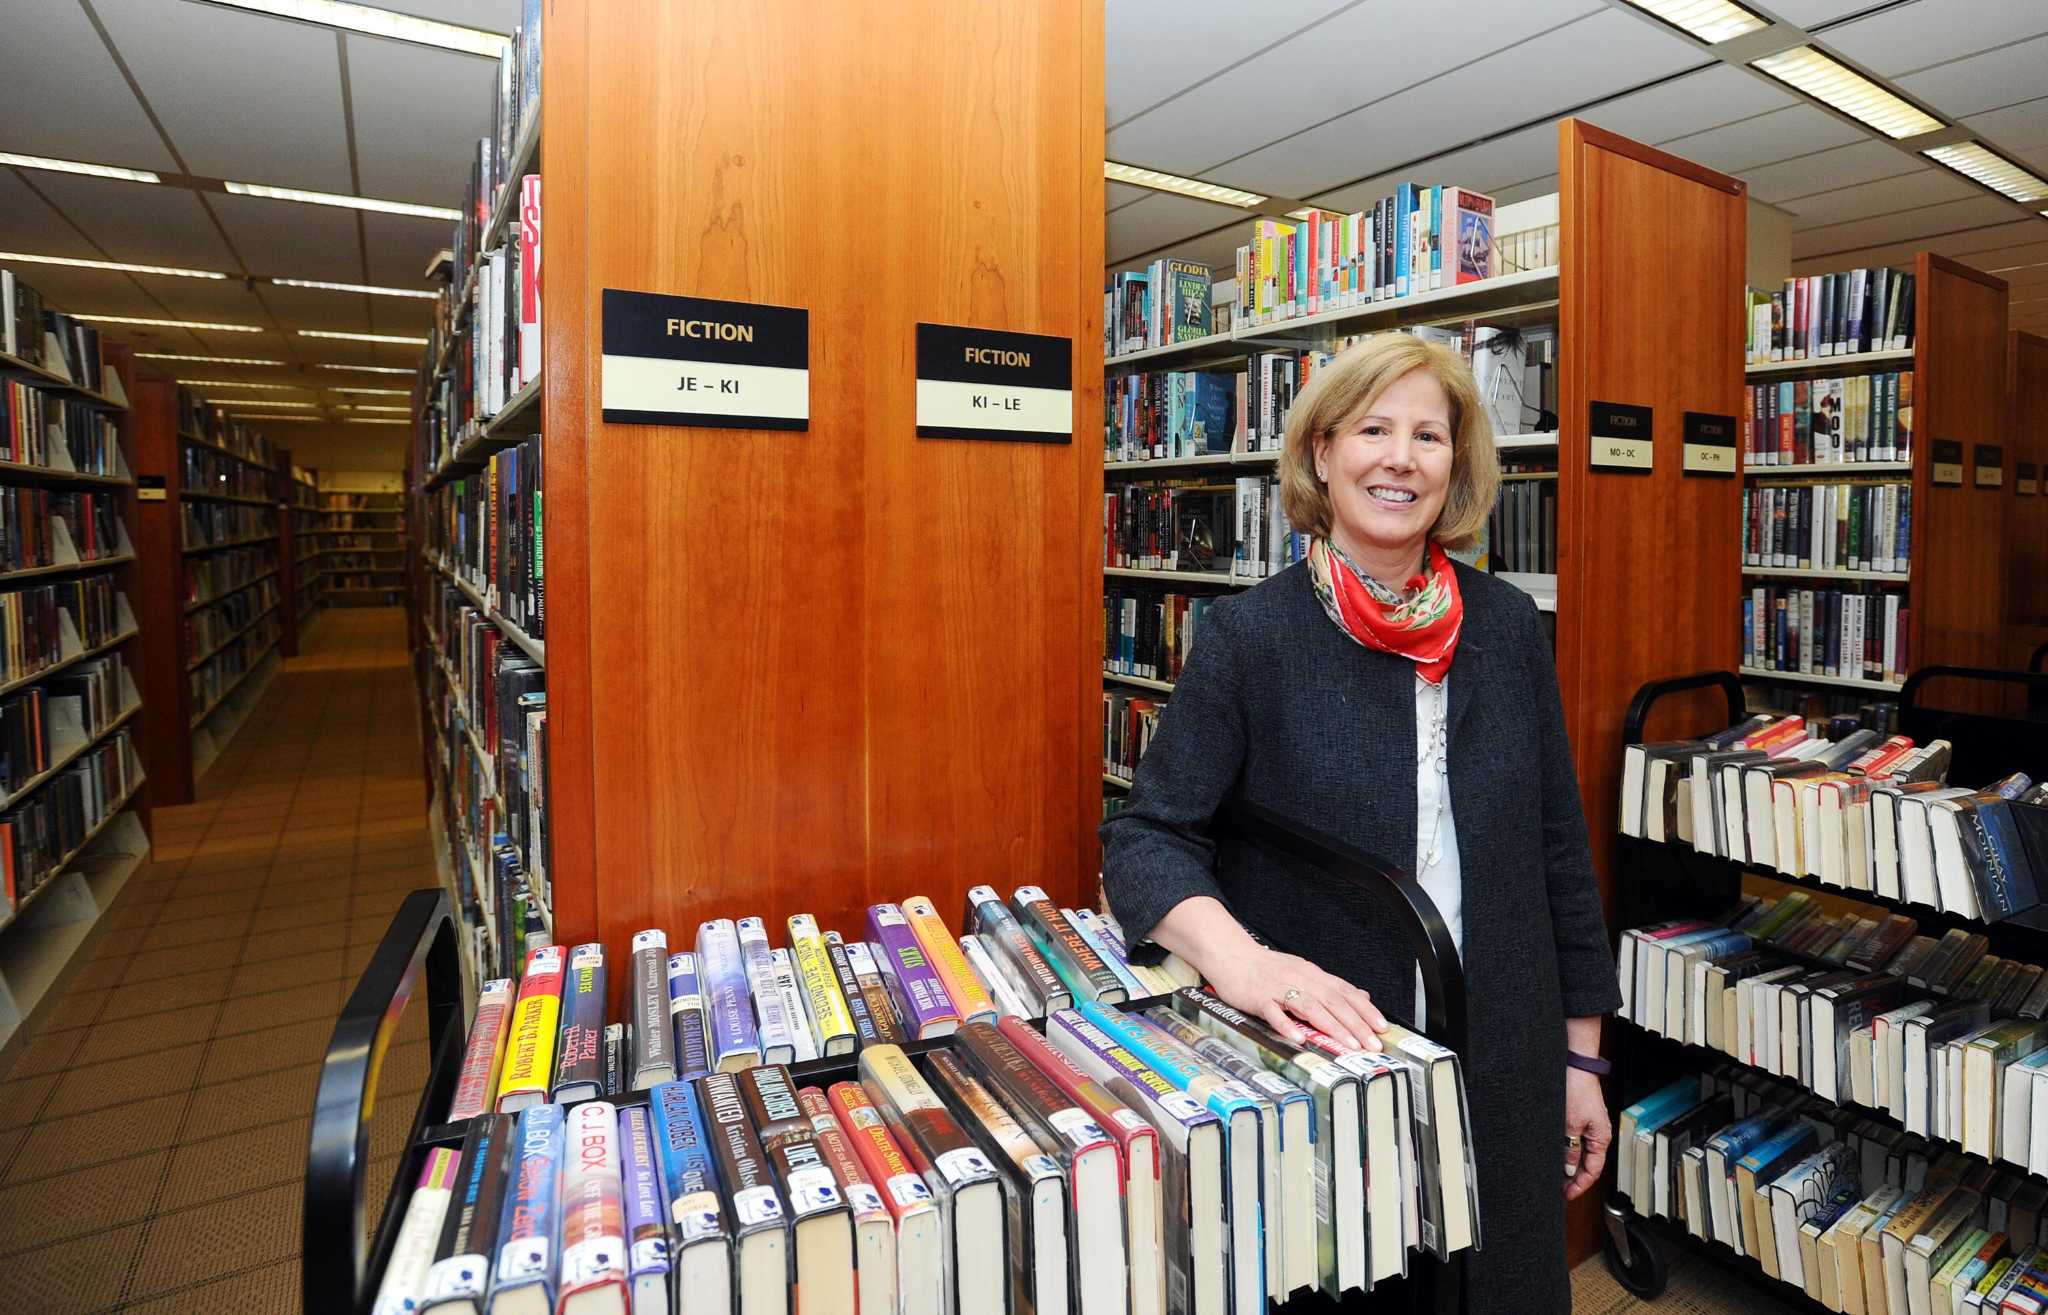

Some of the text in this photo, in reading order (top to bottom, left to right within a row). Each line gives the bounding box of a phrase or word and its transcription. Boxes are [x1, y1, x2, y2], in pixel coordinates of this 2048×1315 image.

[666, 318, 754, 343] FICTION
[964, 347, 1031, 368] FICTION
[677, 377, 698, 392] JE
[721, 379, 739, 394] KI
[972, 396, 988, 409] KI
[1004, 398, 1021, 411] LE
[1609, 415, 1637, 427] FICTION
[1610, 448, 1621, 457] MO
[1626, 448, 1636, 458] OC
[1971, 814, 2008, 912] MOUNTAIN
[1034, 900, 1103, 971] WHERE IT HUR
[896, 944, 926, 969] SILKS
[1010, 932, 1056, 986] WIDOWMAKER
[645, 959, 658, 988] Charcoal
[776, 973, 793, 989] JAR
[802, 966, 820, 986] LIFE
[519, 997, 544, 1031] PARKER
[646, 993, 660, 1028] MOSLEY
[722, 984, 742, 1036] LOUISE PENNY
[808, 983, 832, 1020] SECOND
[1181, 986, 1247, 1026] Sue Grafton
[561, 1036, 579, 1068] Robert
[579, 1028, 598, 1058] Parker
[646, 1029, 661, 1058] Walter
[682, 1011, 704, 1067] MOURNERS
[509, 1041, 535, 1080] ROBERT
[751, 1064, 789, 1096] HARLAN
[1136, 1068, 1176, 1096] SEVEN
[659, 1084, 691, 1119] HARLAN
[761, 1089, 800, 1122] COBEN
[629, 1110, 644, 1131] EILEEN
[666, 1118, 698, 1152] COBEN
[706, 1071, 761, 1189] UNWANTED Kristina Ohlsso
[523, 1130, 549, 1158] BOX
[581, 1135, 606, 1172] BOX
[631, 1131, 649, 1167] DEWHURST
[783, 1141, 819, 1166] LIVE
[867, 1126, 894, 1152] DEATH
[680, 1169, 703, 1193] ONE
[839, 1158, 862, 1185] MURDE
